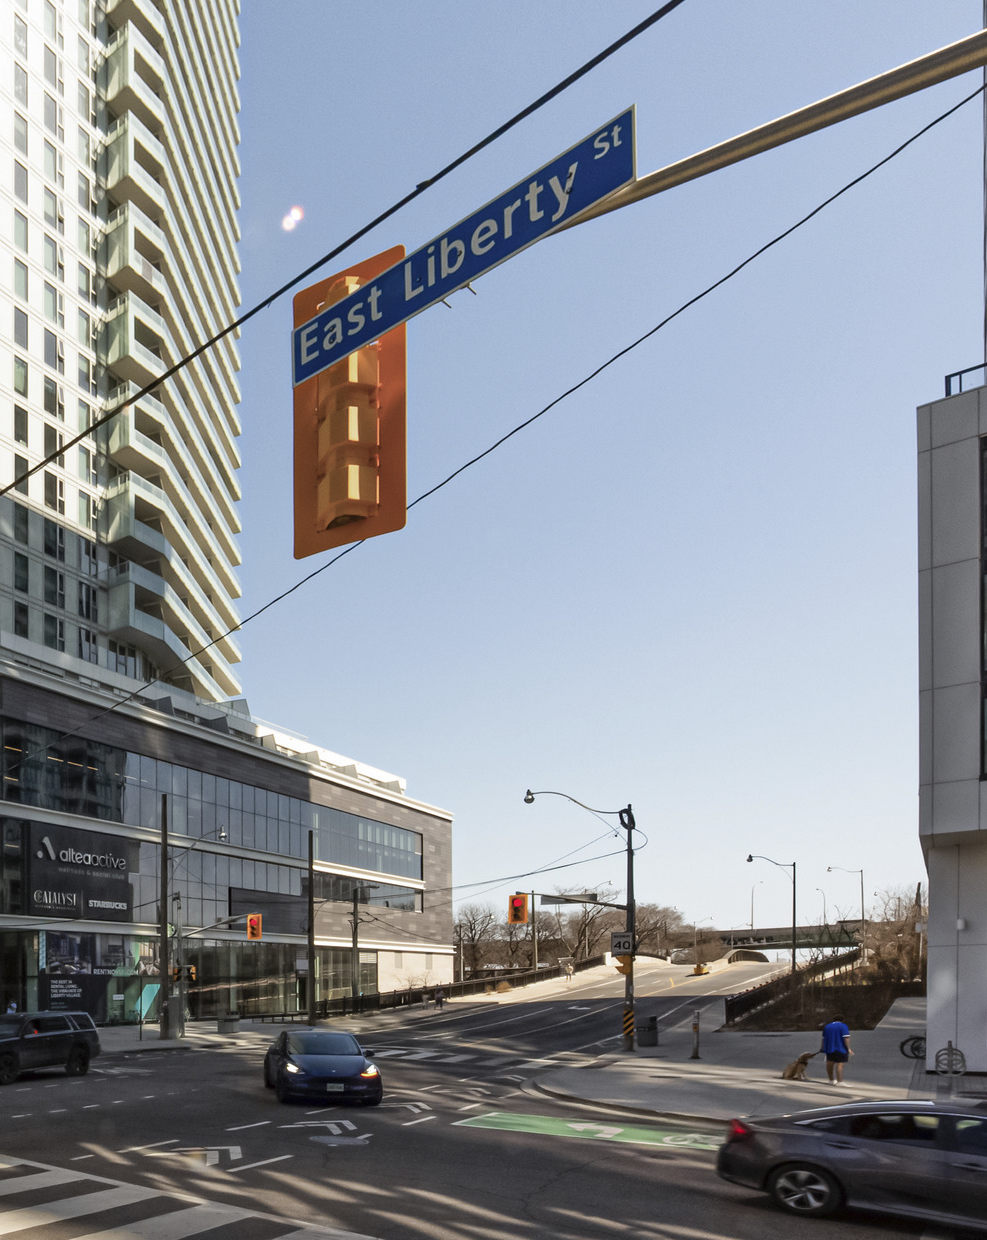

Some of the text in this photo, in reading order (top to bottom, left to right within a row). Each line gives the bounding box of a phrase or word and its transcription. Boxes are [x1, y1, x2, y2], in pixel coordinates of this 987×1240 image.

[301, 124, 622, 365] East Liberty St
[59, 848, 126, 869] alteaactive
[34, 890, 76, 906] CATALYST
[88, 900, 127, 910] STARBUCKS
[613, 940, 631, 950] 40
